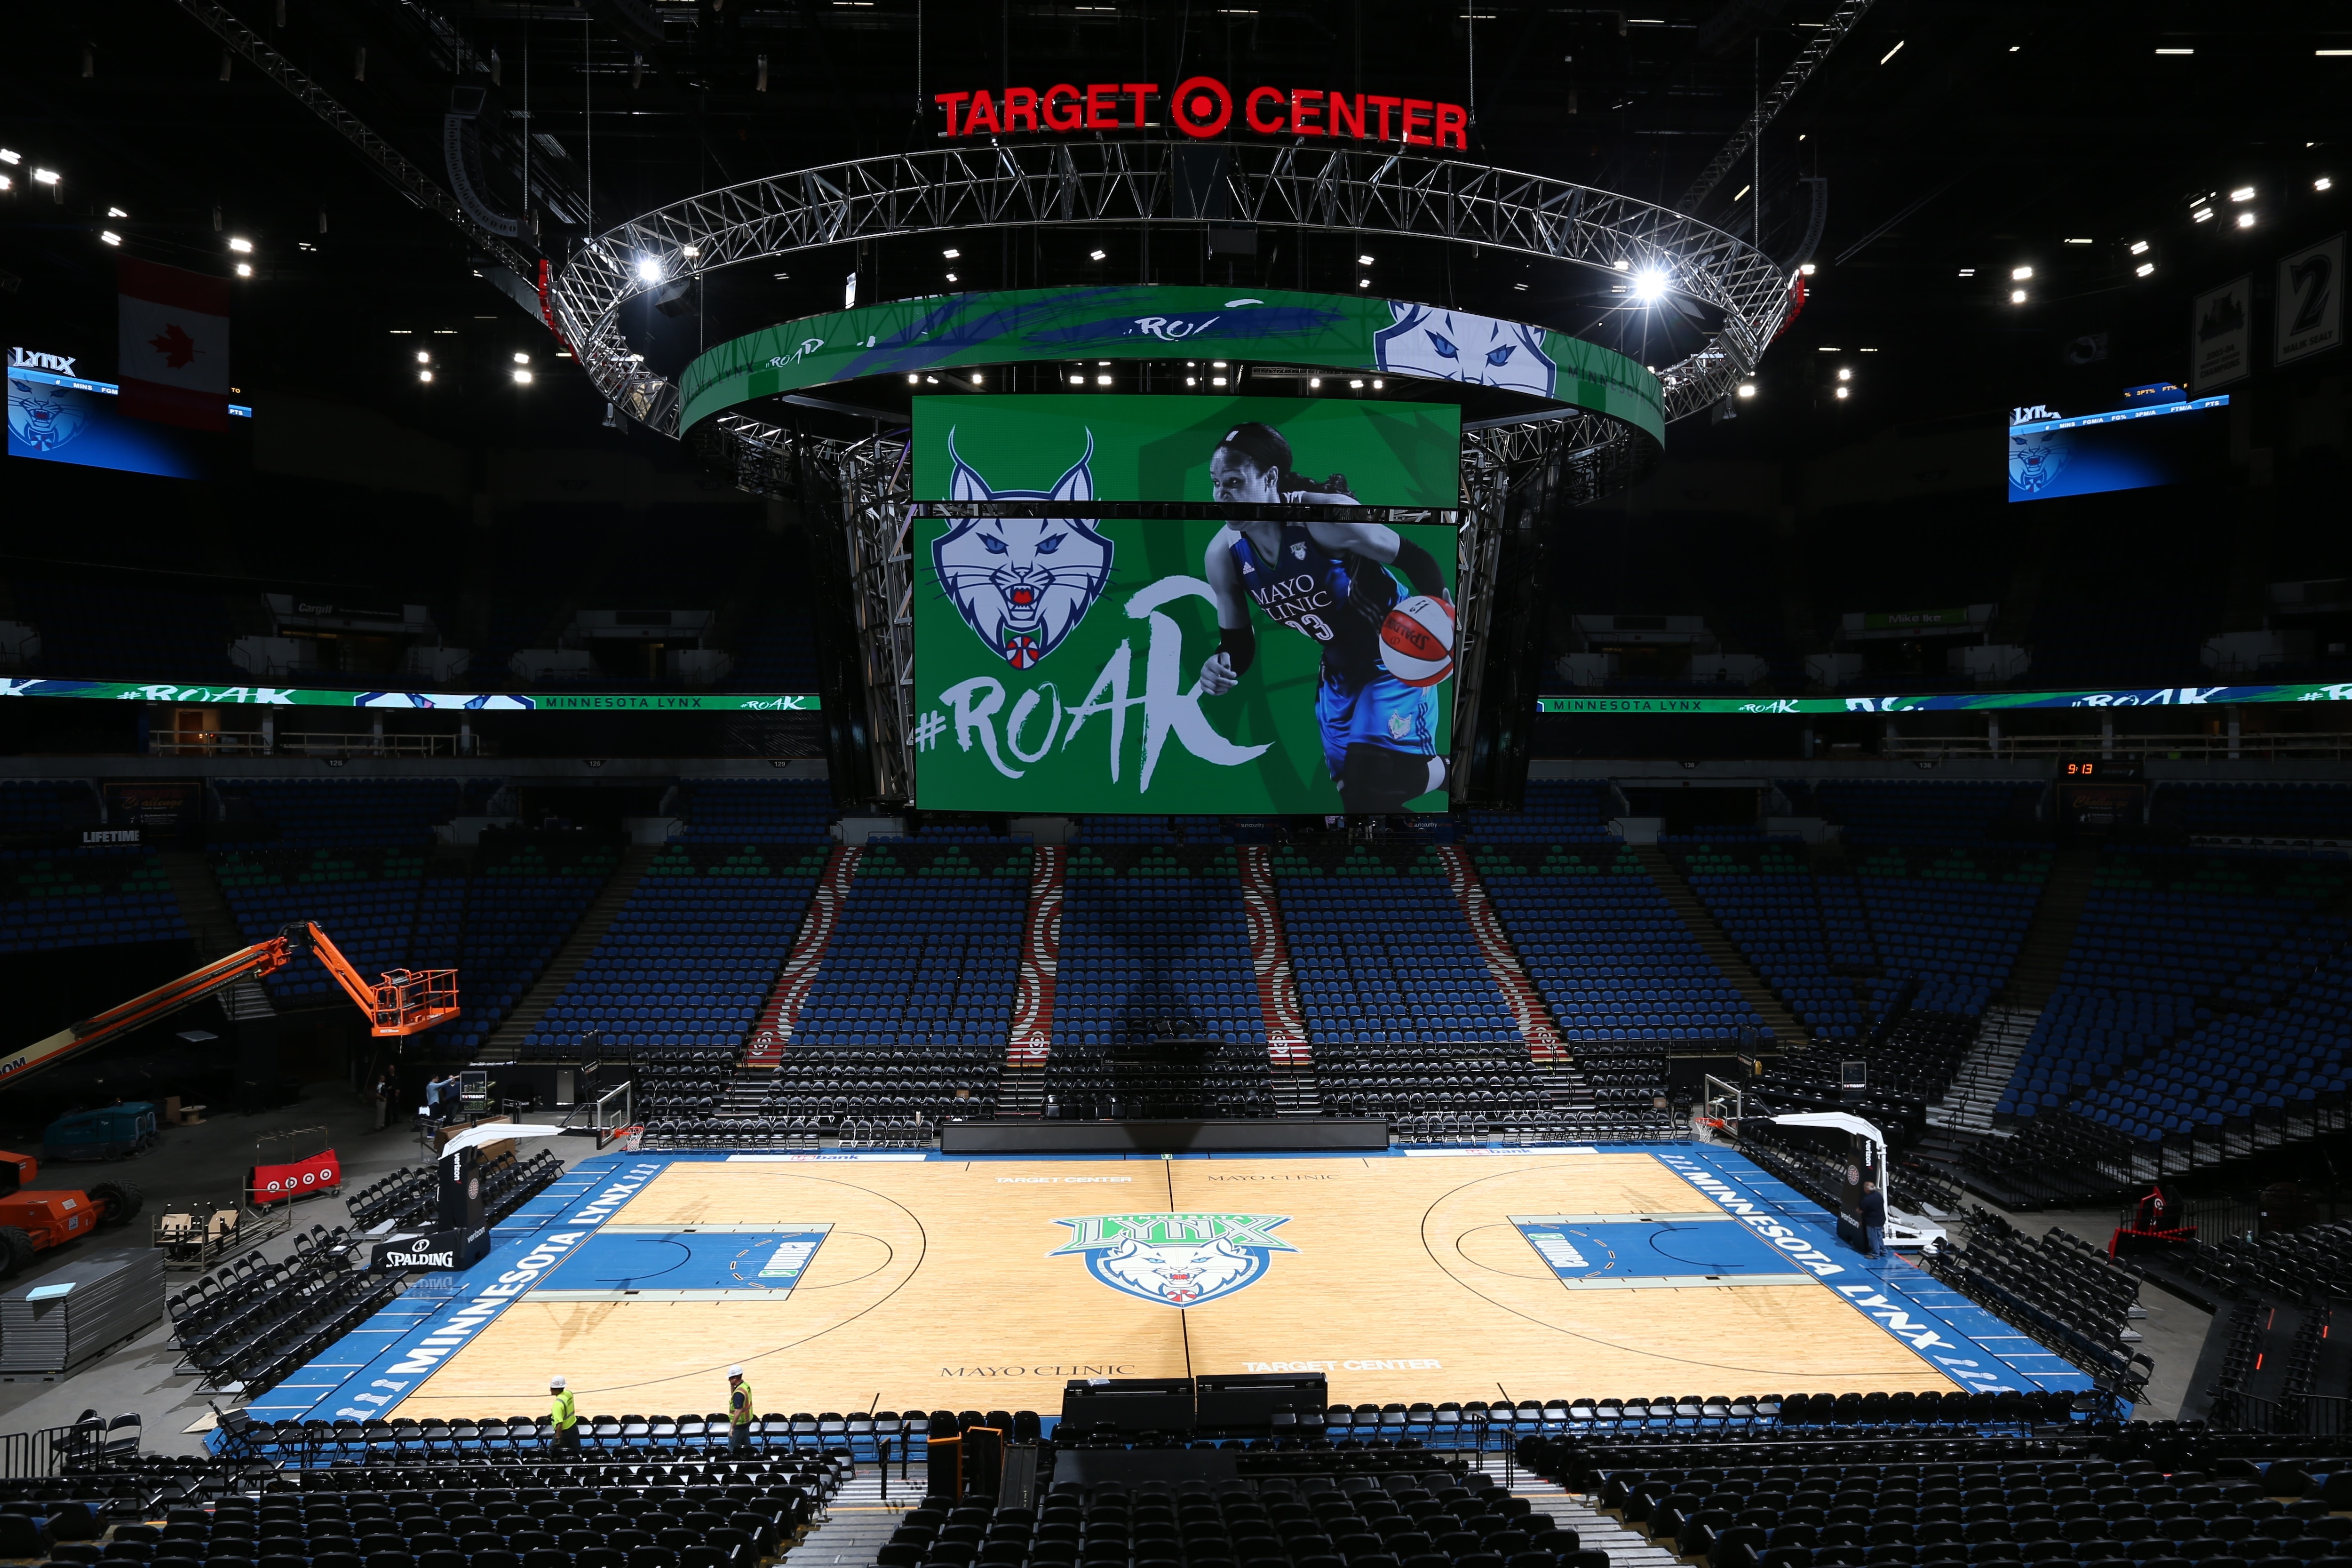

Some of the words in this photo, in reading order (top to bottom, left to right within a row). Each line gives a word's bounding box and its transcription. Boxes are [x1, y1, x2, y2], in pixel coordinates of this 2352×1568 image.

[935, 83, 1159, 140] TARGET
[1246, 86, 1468, 152] CENTER
[2290, 254, 2332, 337] 2
[2283, 339, 2307, 354] MALIK
[2309, 330, 2333, 345] SEALY
[2206, 344, 2234, 360] 2003-04
[12, 347, 77, 377] LYNX
[2200, 358, 2240, 378] CHAMPIONS
[73, 382, 93, 391] MINS
[101, 387, 118, 396] FGM
[2170, 404, 2192, 413] FTM/A
[1251, 574, 1314, 605] MAYO
[298, 603, 332, 615] Cargill
[1261, 591, 1332, 621] LINIC
[1889, 614, 1919, 623] Mike
[546, 696, 648, 708] MINNESOTA
[658, 696, 702, 708] LYNX
[1554, 700, 1652, 711] MINNESOTA
[1661, 700, 1701, 711] LYNX
[2067, 763, 2093, 775] 9:13
[83, 830, 140, 843] LIFETIME
[0, 1056, 27, 1075] OM
[1841, 1211, 1859, 1229] verizon
[467, 1226, 485, 1243] verizon
[1076, 1216, 1279, 1246] LYNX
[386, 1251, 453, 1268] SPALDING
[1688, 1171, 1844, 1276] MINNESOTA
[1837, 1285, 1955, 1349] LYNX
[385, 1231, 585, 1374] MINNESOTA
[569, 1183, 642, 1224] LYNX
[941, 1367, 1025, 1377] MAYO
[1034, 1365, 1135, 1376] CLINIC
[1242, 1361, 1337, 1372] TARGET
[1343, 1359, 1442, 1370] CENTER
